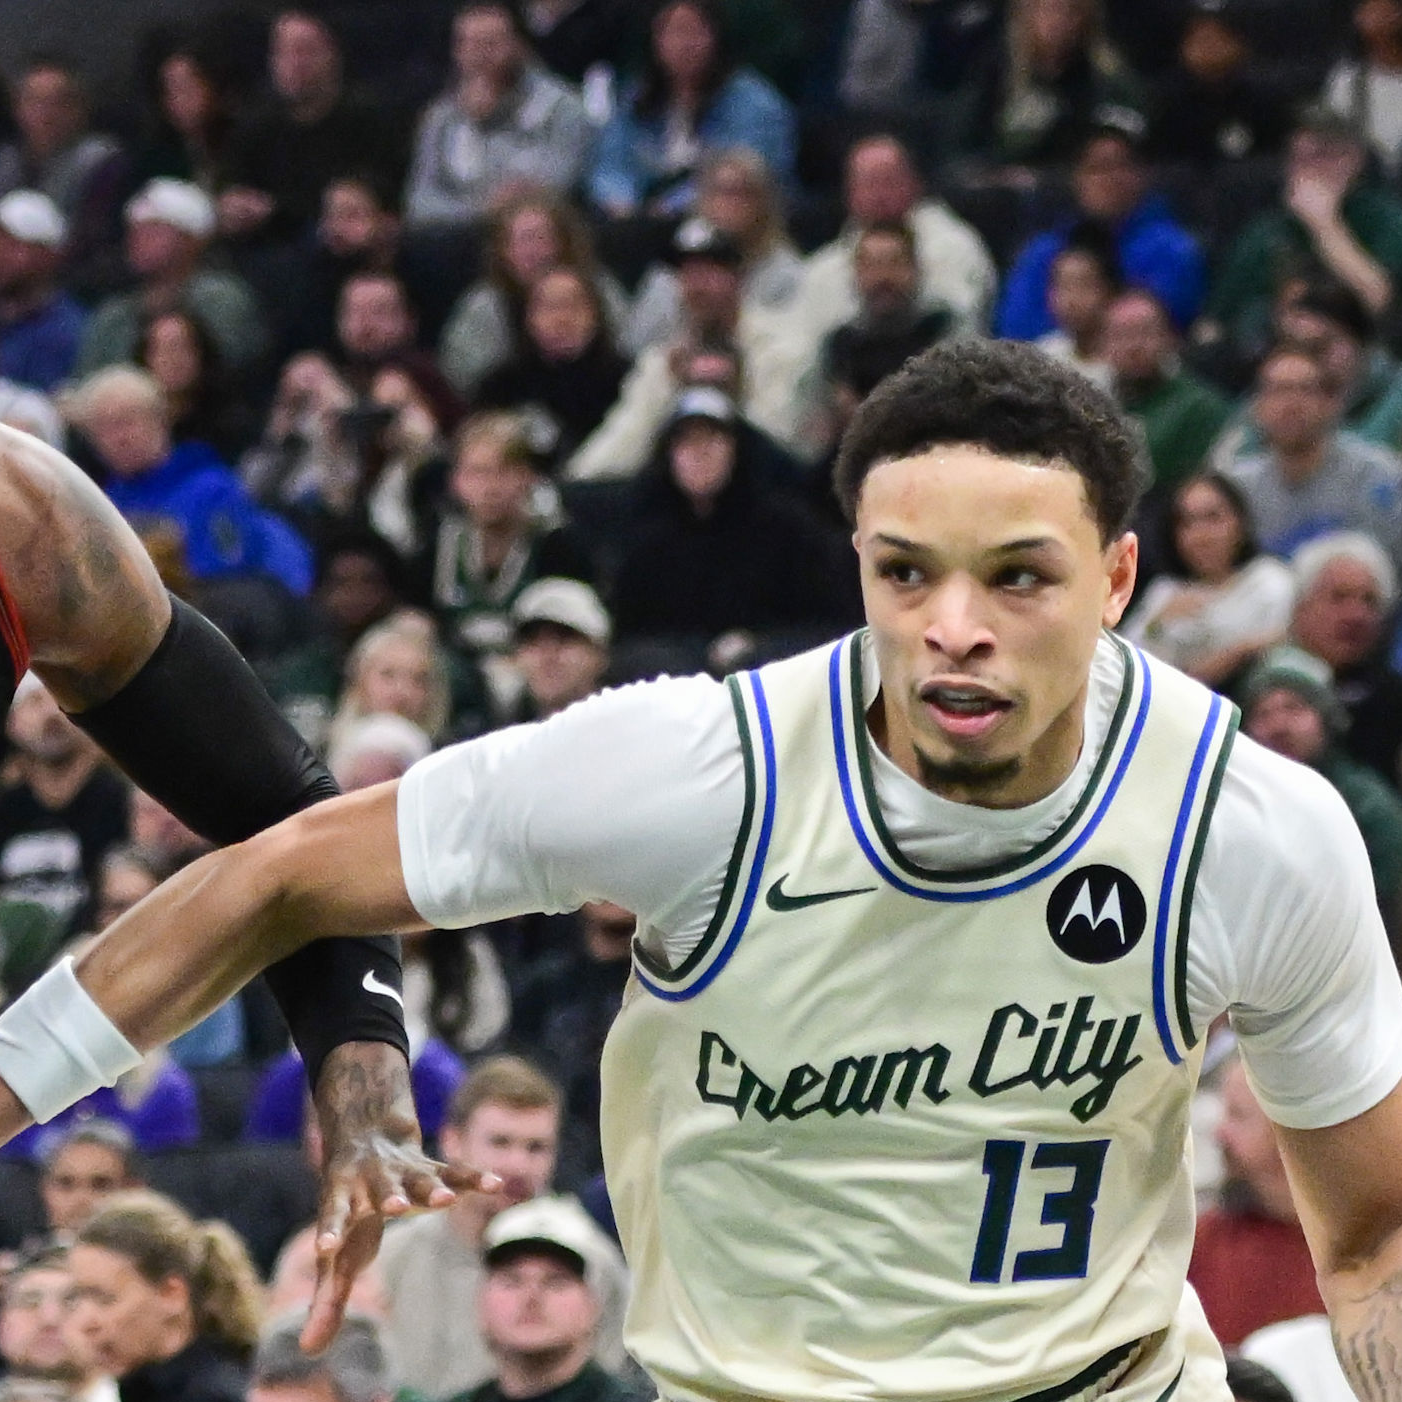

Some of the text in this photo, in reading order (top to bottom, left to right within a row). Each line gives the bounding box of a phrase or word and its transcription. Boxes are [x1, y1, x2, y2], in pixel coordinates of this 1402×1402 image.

[696, 995, 1145, 1124] Cream City
[969, 1138, 1111, 1284] 13
